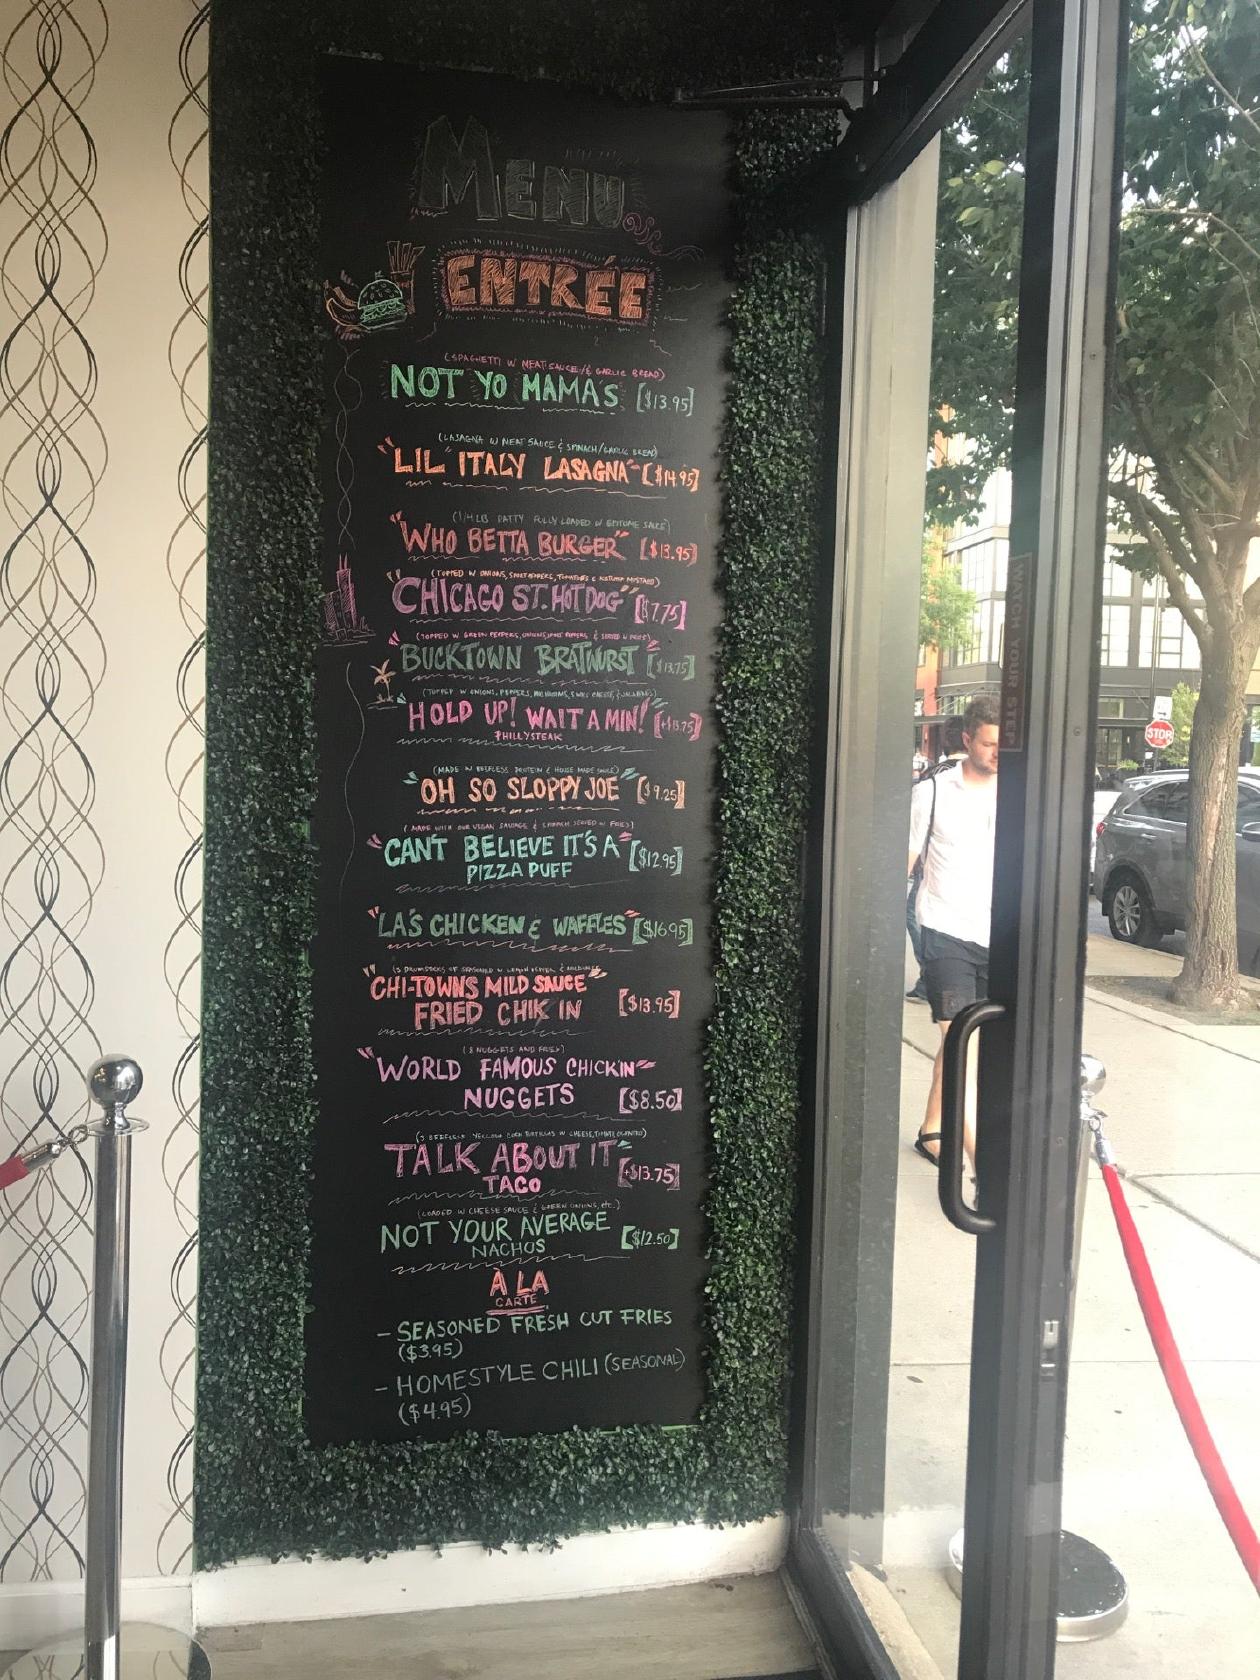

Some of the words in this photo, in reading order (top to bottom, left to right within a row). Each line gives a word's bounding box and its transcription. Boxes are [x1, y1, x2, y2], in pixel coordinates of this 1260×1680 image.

[390, 363, 465, 399] NOT
[474, 369, 508, 400] YO
[528, 438, 556, 449] SAUCE
[459, 451, 526, 479] ITALY
[560, 518, 592, 527] LOADED
[467, 528, 530, 554] BETTA
[1010, 562, 1026, 630] WATCH
[1008, 637, 1021, 690] YOUR
[484, 697, 516, 728] UP!
[524, 706, 585, 730] WAIT
[586, 708, 601, 731] A
[1005, 695, 1018, 747] STEP
[1147, 727, 1173, 741] STOP
[554, 766, 575, 774] HOUSE
[468, 777, 497, 802] SO
[507, 775, 581, 802] SLOPPY
[464, 834, 555, 863] BELIEVE
[467, 861, 524, 885] PIZZA
[528, 861, 573, 879] PUFF
[429, 912, 526, 937] CHICKEN
[483, 974, 529, 999] MILD
[414, 999, 483, 1030] FRIED
[518, 1045, 536, 1054] AND
[480, 1056, 557, 1081] FAMOUS
[464, 1083, 575, 1111] NUGGETS
[384, 1141, 481, 1178] TALK
[490, 1142, 581, 1174] ABOUT
[482, 1175, 541, 1195] TACO
[468, 1207, 501, 1215] CHEESE
[503, 1206, 529, 1215] SAUCE
[380, 1221, 441, 1254] NOT
[448, 1216, 512, 1244] YOUR
[520, 1210, 611, 1238] AVERAGE
[472, 1238, 547, 1259] NACHOS
[516, 1269, 550, 1297] LA
[495, 1293, 538, 1307] CARTE
[397, 1316, 500, 1343] SEASONED
[511, 1312, 570, 1335] FRESH
[579, 1309, 614, 1326] CUT
[620, 1308, 673, 1326] FRIES
[396, 1362, 537, 1398] HOMESTYLE
[541, 1356, 598, 1380] CHILI
[604, 1347, 686, 1376] (SEASONAL)
